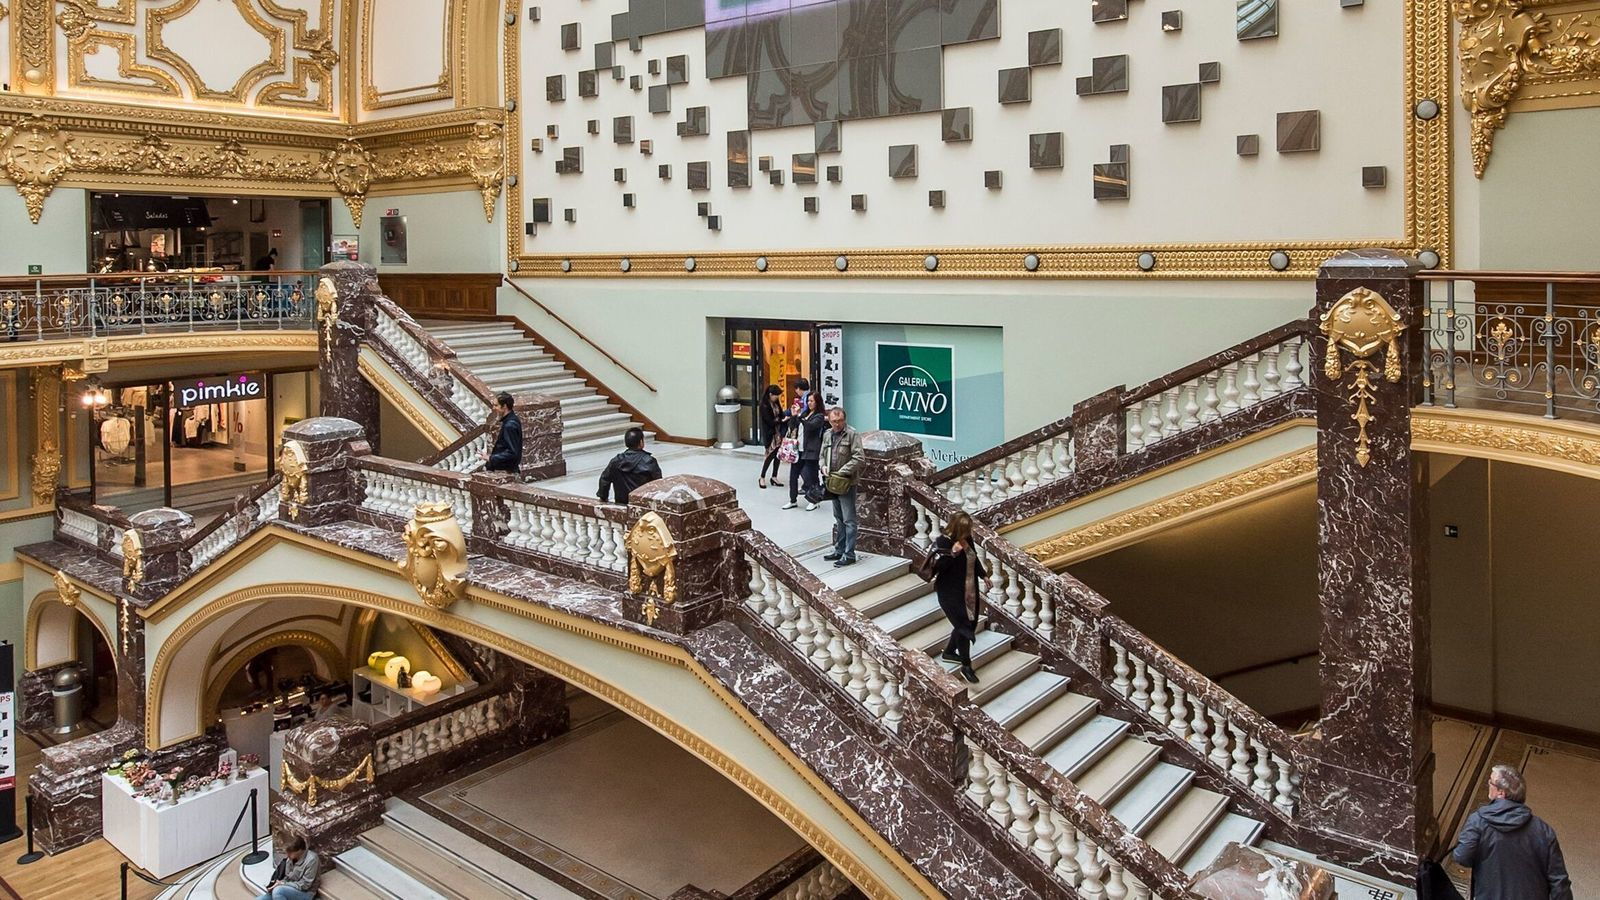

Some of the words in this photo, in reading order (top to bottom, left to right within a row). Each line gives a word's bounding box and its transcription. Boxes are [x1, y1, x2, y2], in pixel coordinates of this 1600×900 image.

[822, 331, 840, 339] SHOPS
[181, 375, 260, 406] pimkie
[898, 376, 928, 388] GALERIA
[888, 389, 947, 414] INNO
